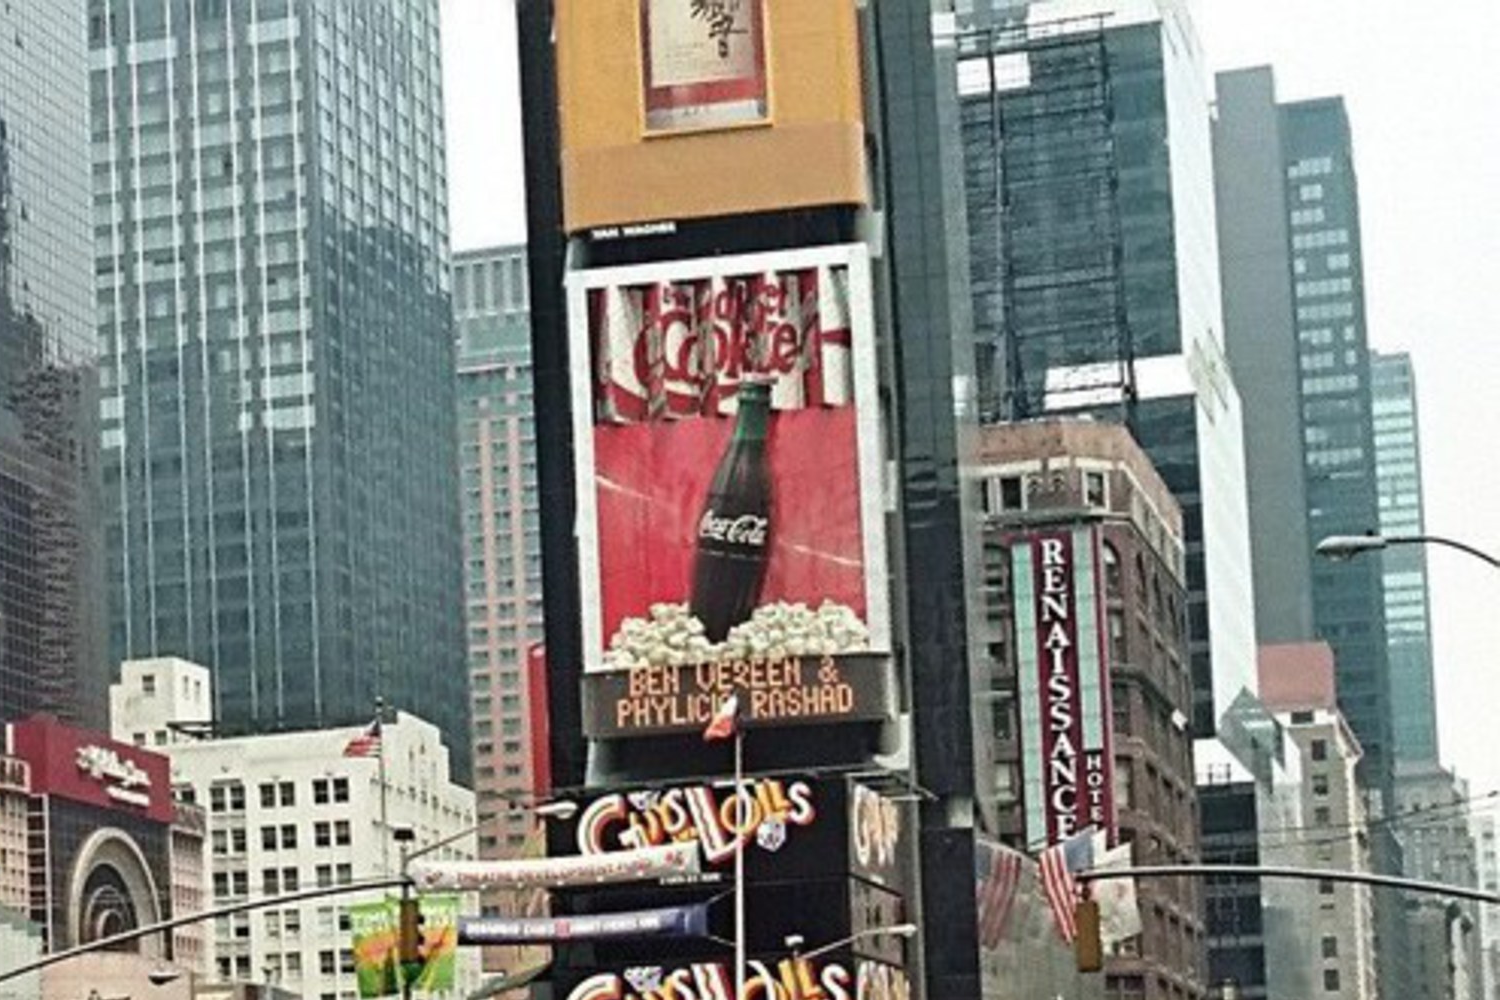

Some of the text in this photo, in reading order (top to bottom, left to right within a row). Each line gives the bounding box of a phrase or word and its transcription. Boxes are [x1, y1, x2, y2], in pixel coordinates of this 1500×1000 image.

[629, 666, 679, 696] BEN
[818, 658, 840, 683] &
[1040, 538, 1078, 842] RENAISSANCE
[751, 685, 853, 718] RASHAD
